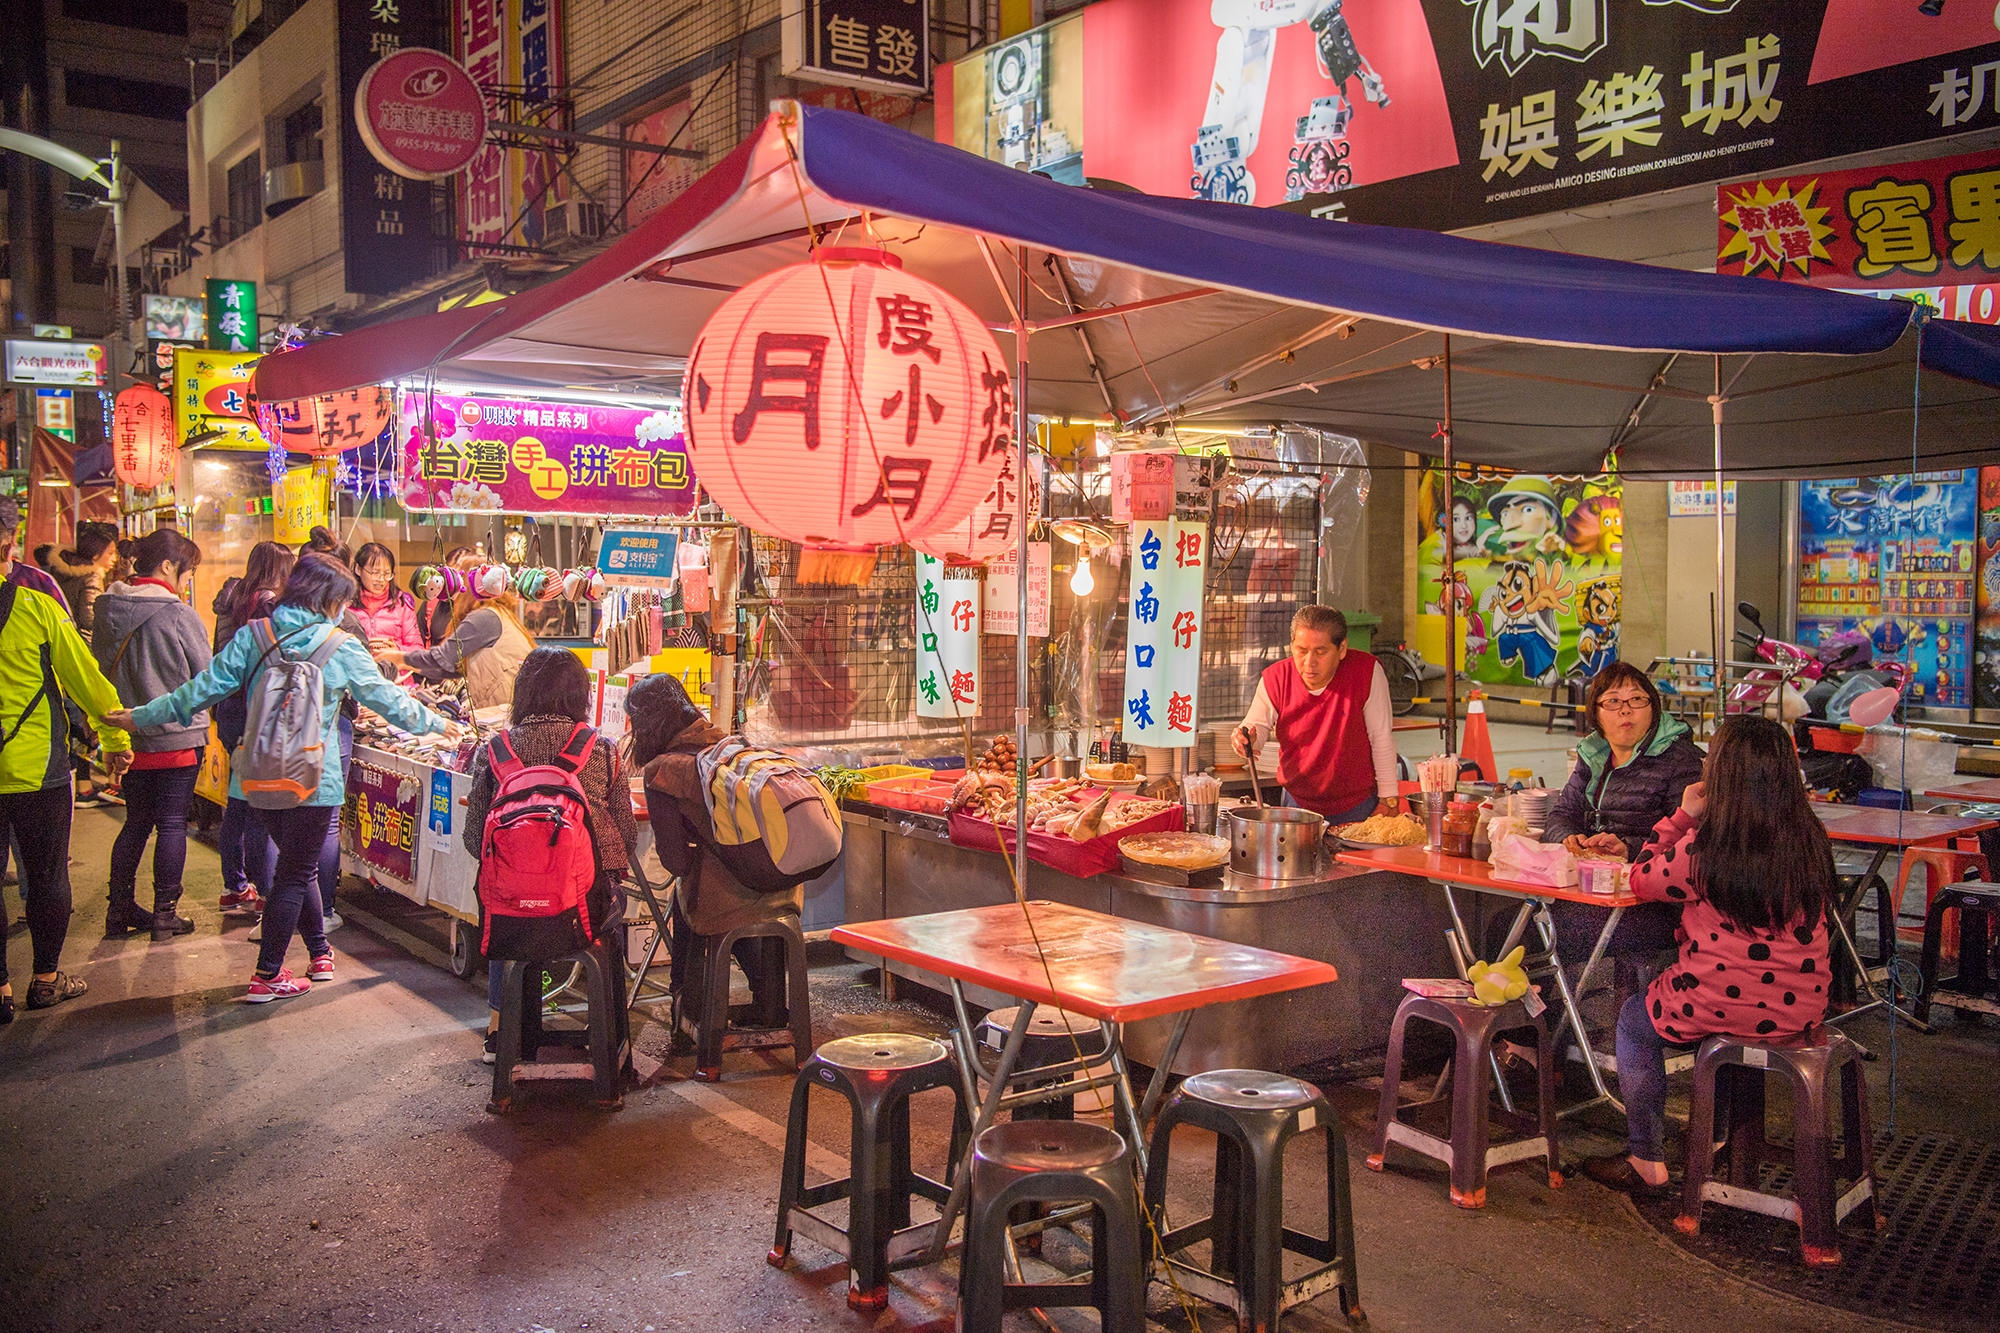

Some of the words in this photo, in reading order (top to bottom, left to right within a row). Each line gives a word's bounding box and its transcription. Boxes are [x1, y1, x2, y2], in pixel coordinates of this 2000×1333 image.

[1479, 33, 1782, 183] 娛樂城
[1554, 174, 1583, 189] AMIGO
[1584, 167, 1616, 183] DESING
[1617, 167, 1626, 177] LES
[1702, 149, 1716, 160] AND
[1717, 144, 1737, 156] HENRY
[374, 173, 403, 236] 精品
[16, 356, 89, 370] 六合觀光夜市
[118, 401, 151, 416] 六合
[222, 390, 244, 412] 七
[733, 331, 830, 451] 月
[851, 293, 945, 522] 度小月
[321, 409, 365, 446] 手工
[523, 409, 588, 429] 精品系列
[120, 417, 140, 471] 七里香
[420, 437, 690, 494] 台灣手工拼布包
[620, 537, 659, 549] 欢迎使用
[1826, 504, 1950, 536] 水滸傳
[628, 552, 659, 564] 支付宝
[919, 553, 941, 706] 南口味
[1128, 528, 1162, 731] 台南口味
[1167, 529, 1202, 734] 担仔麵
